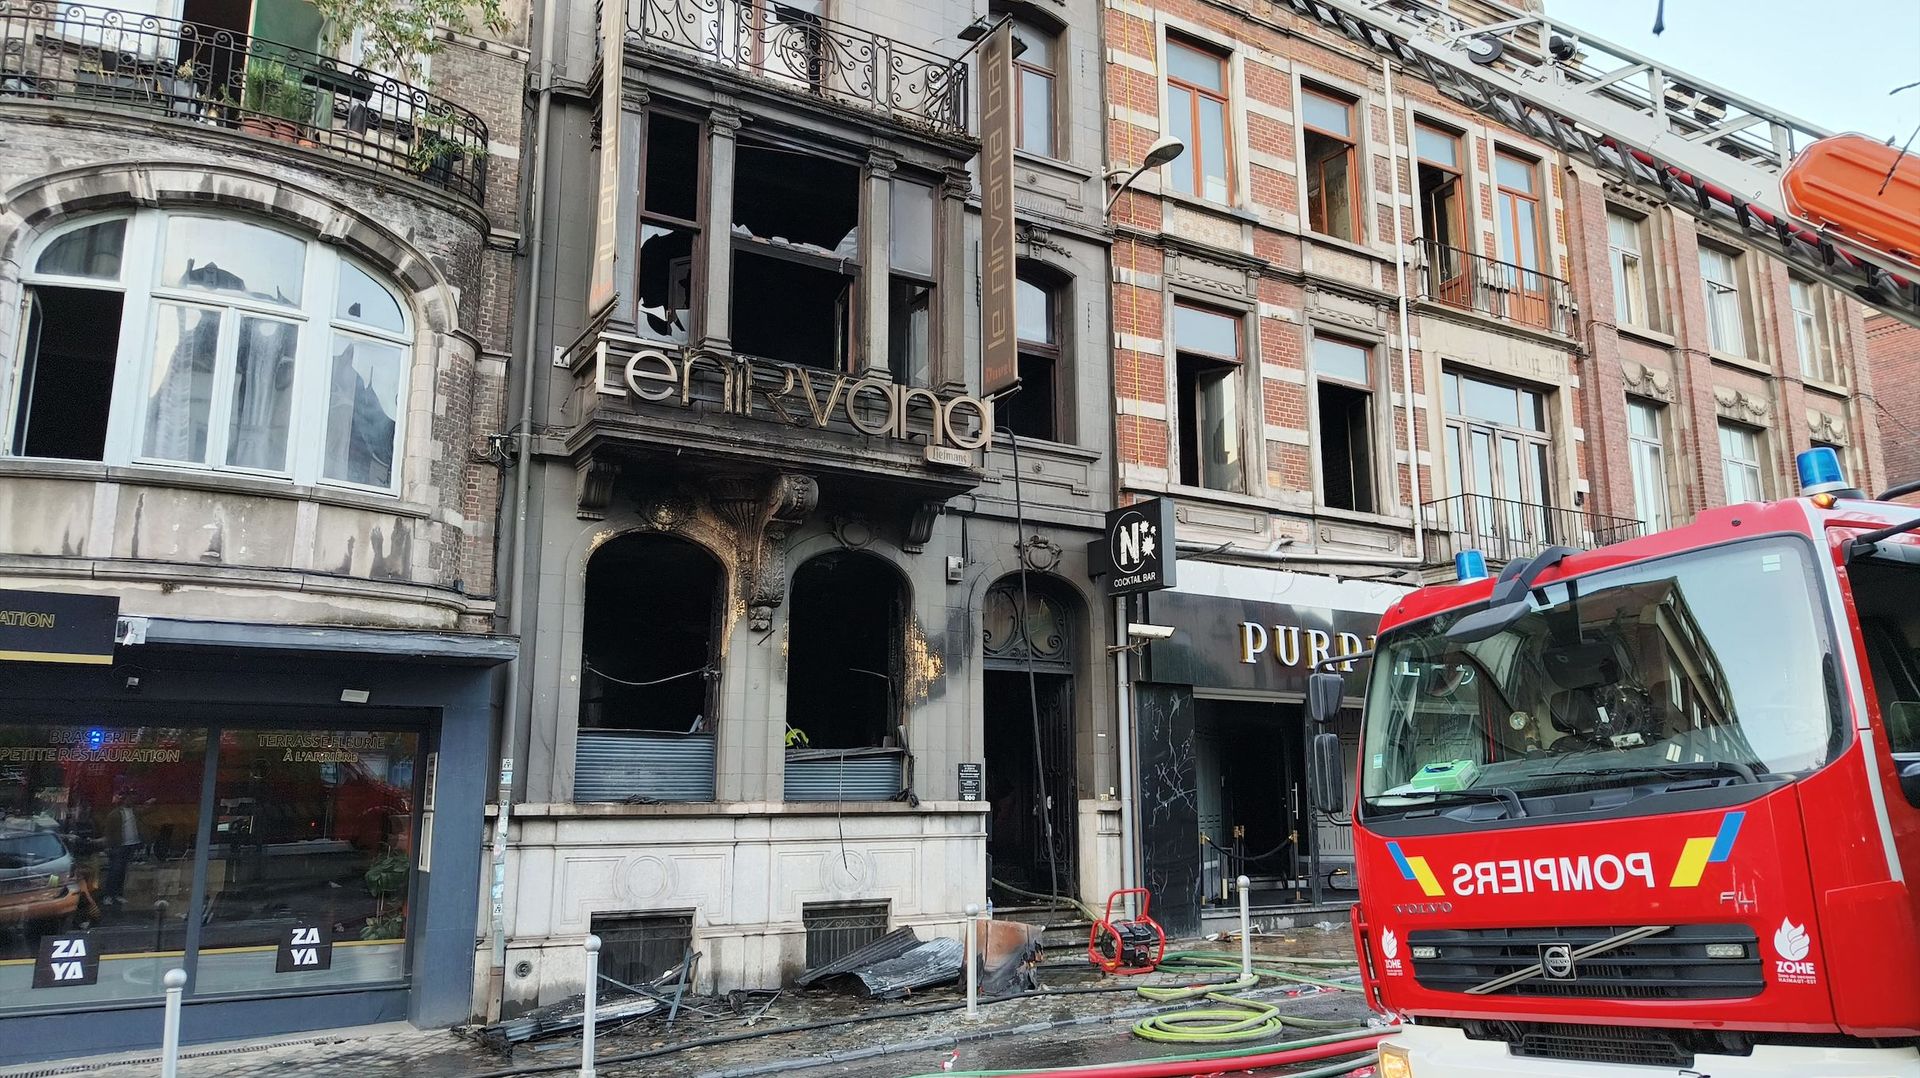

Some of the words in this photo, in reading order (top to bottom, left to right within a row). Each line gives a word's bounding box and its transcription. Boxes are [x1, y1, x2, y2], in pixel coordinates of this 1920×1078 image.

[984, 50, 1002, 121] bar
[986, 127, 1005, 294] nirvana
[988, 305, 1005, 350] le
[1113, 575, 1143, 588] COCKTAIL
[1143, 571, 1156, 582] BAR
[1239, 621, 1378, 672] PURP
[258, 734, 330, 749] TERRASSE
[331, 736, 386, 749] FLEURIE
[0, 747, 57, 761] PETITE
[57, 748, 180, 762] RESTAURATION
[1393, 902, 1453, 914] VOLVO
[1776, 961, 1815, 974] ZOHE
